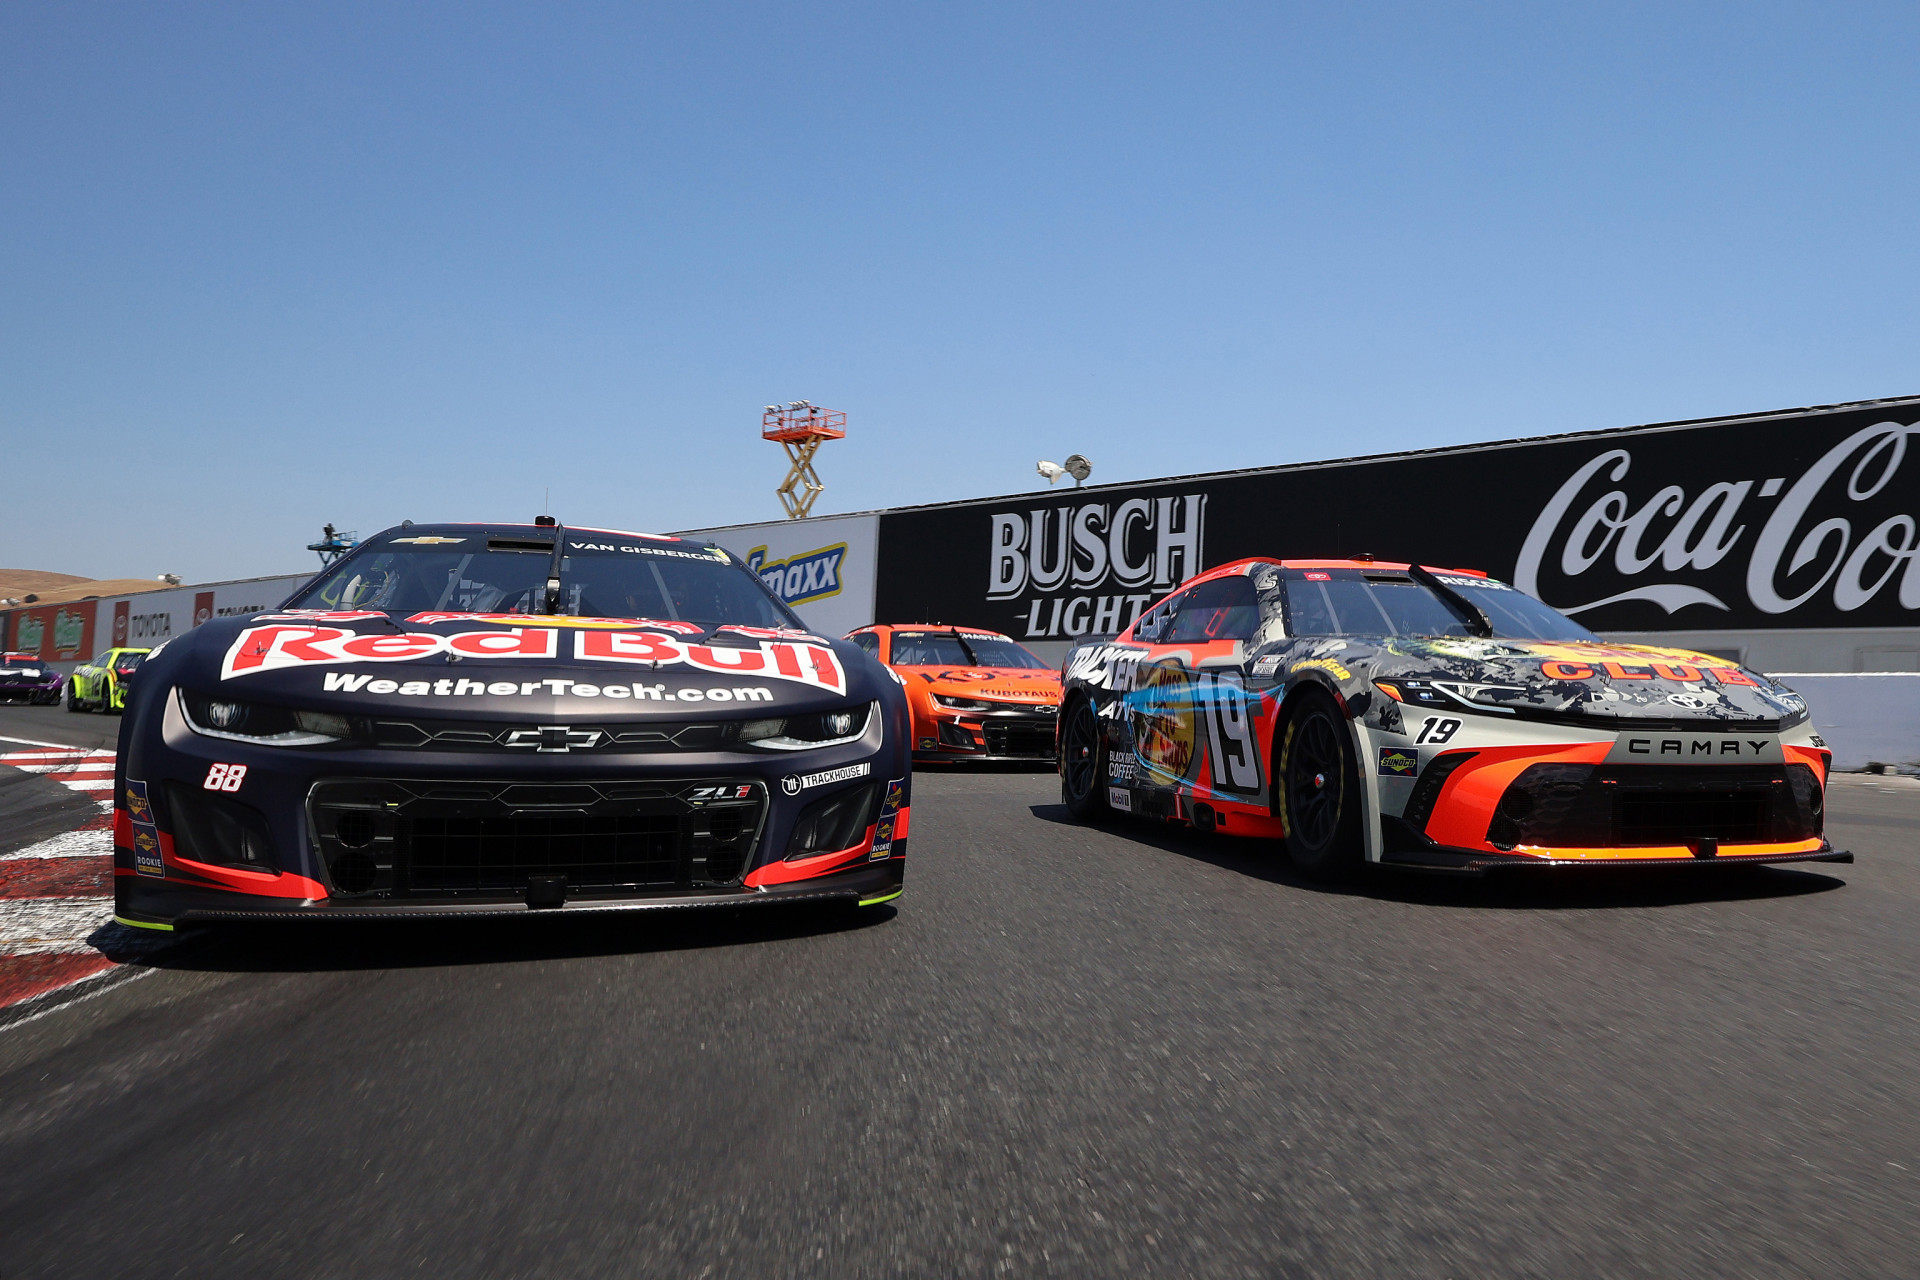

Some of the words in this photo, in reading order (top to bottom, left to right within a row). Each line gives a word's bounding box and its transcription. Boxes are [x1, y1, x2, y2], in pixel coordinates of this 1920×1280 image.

[1513, 421, 1920, 616] Coca-Co
[569, 542, 615, 552] VAN
[987, 494, 1208, 600] BUSCH
[131, 612, 171, 639] TOYOTA
[221, 625, 559, 681] Red
[573, 630, 847, 696] Bull
[1066, 646, 1149, 691] TRACKER
[1290, 658, 1352, 681] GOODYEAR
[1541, 660, 1760, 687] CLUB
[953, 715, 961, 725] 1
[1197, 669, 1260, 790] 19
[1414, 717, 1462, 745] 19
[1109, 750, 1126, 763] BLACK
[1628, 738, 1770, 755] CAMRY
[805, 764, 862, 786] TRACKHOUSE
[1108, 762, 1135, 780] COFFEE
[1382, 759, 1415, 768] SUNOCO
[203, 762, 248, 792] 88
[688, 785, 751, 801] ZL1
[137, 856, 162, 867] ROOKIE
